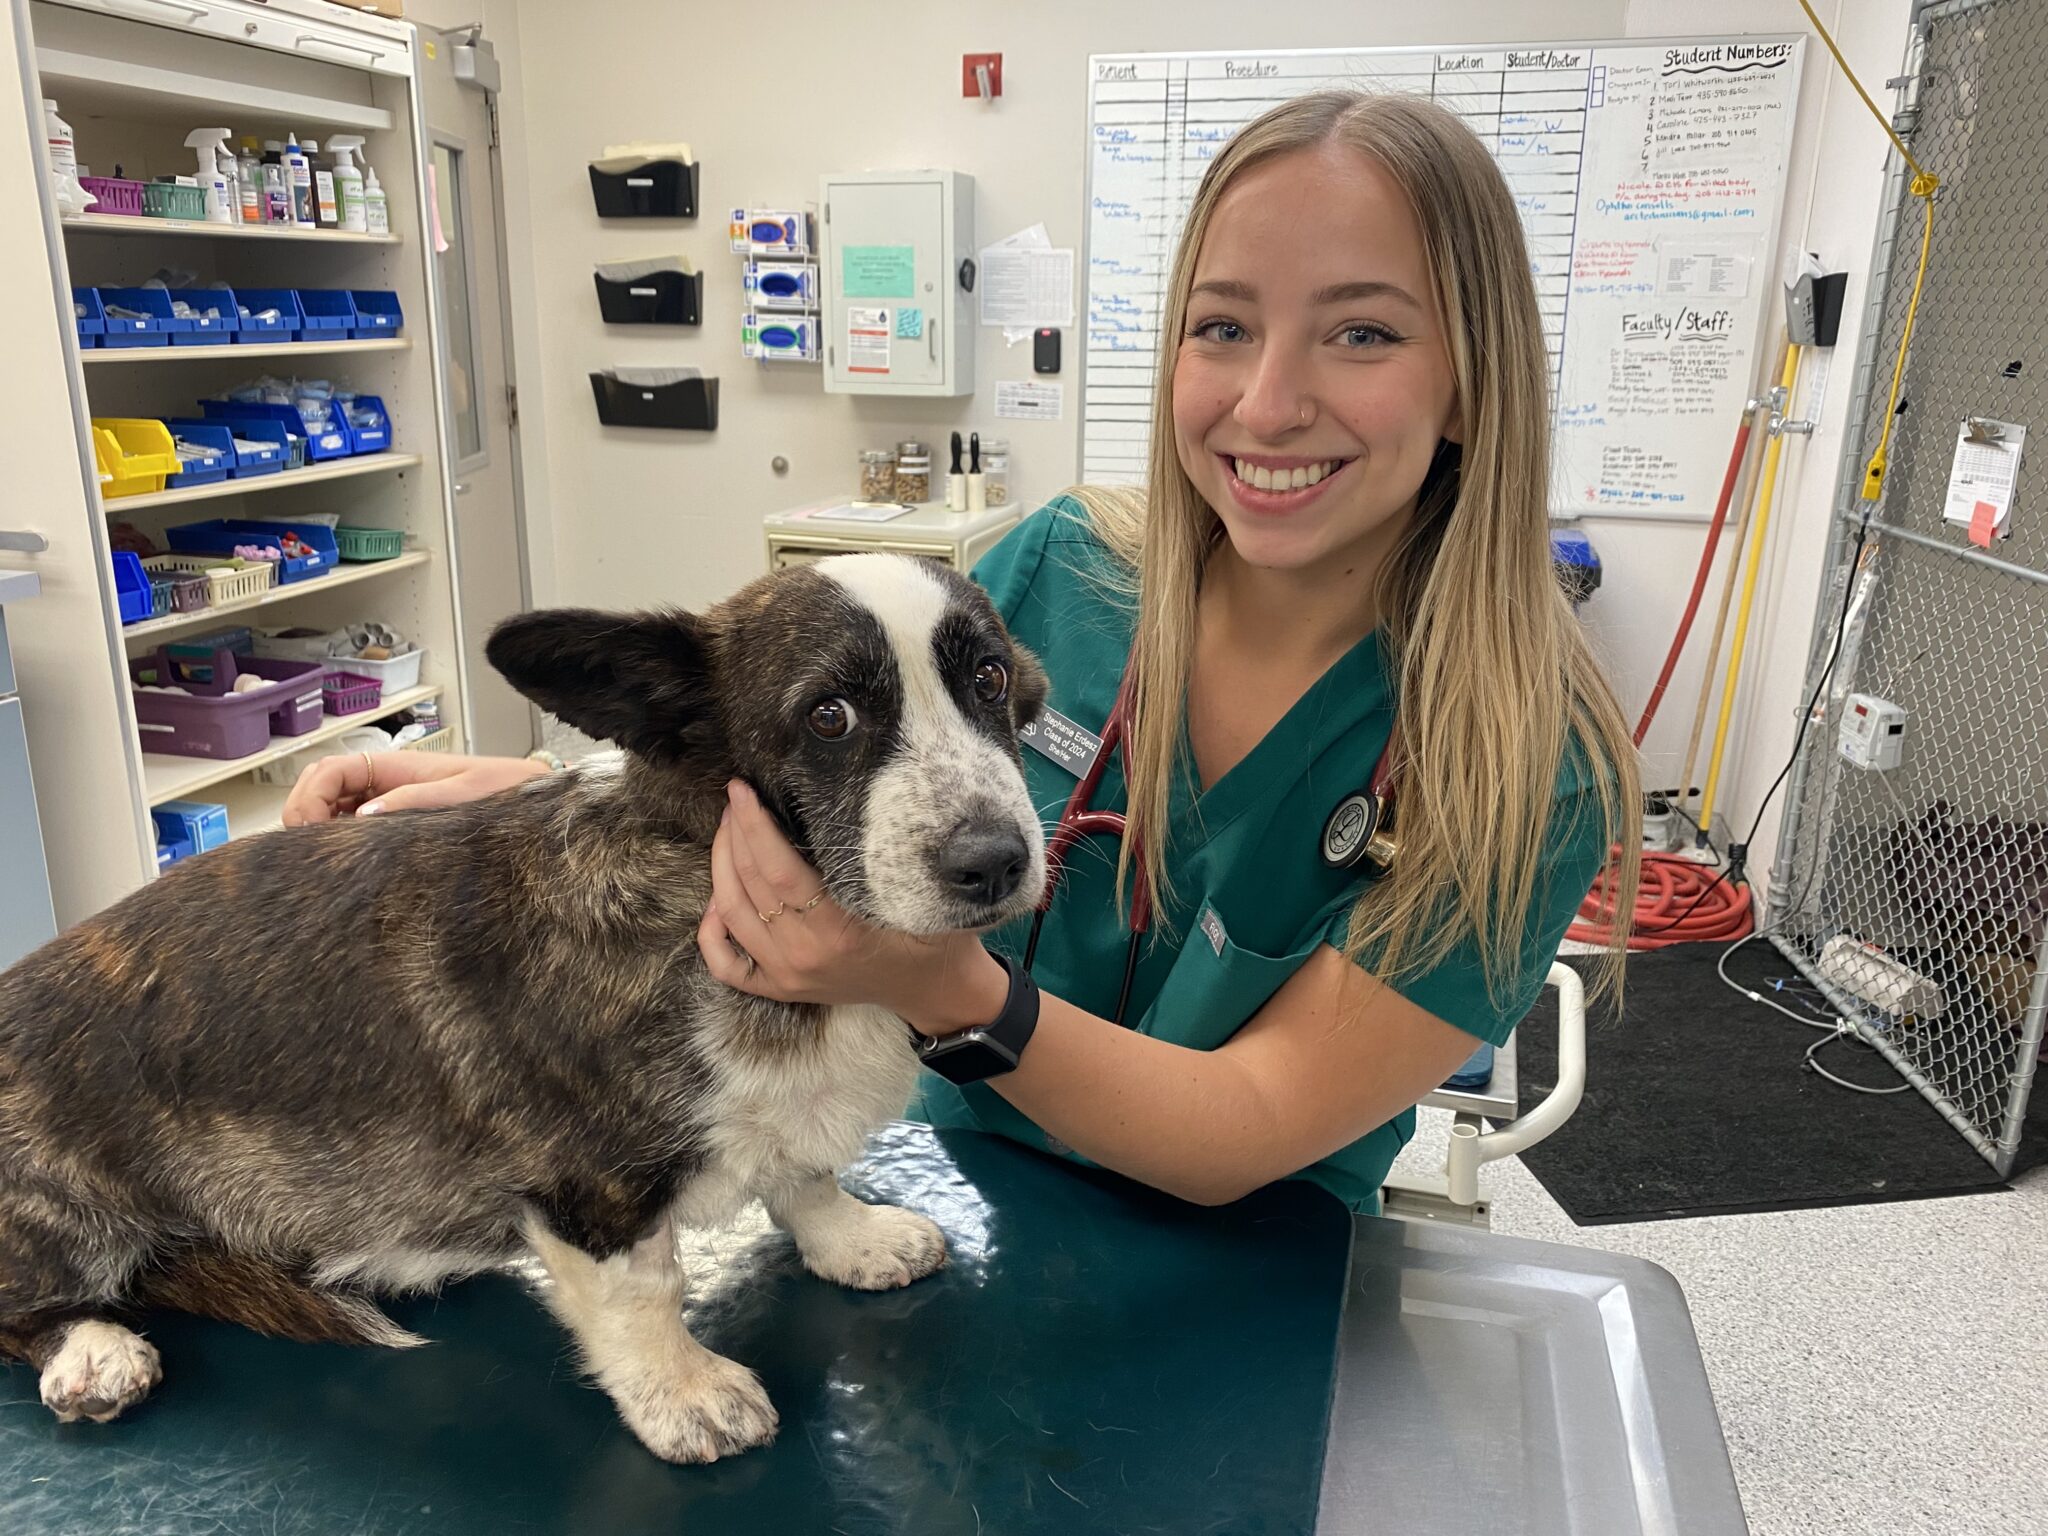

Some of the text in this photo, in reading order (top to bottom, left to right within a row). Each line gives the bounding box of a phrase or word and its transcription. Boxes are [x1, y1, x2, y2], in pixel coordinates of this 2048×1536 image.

[1438, 55, 1484, 70] Location
[1507, 51, 1580, 69] Student/Doctor
[1663, 44, 1792, 67] Student Numbers:
[1099, 63, 1138, 79] Patient
[1225, 61, 1279, 78] Procedure
[1644, 134, 1652, 147] 5
[1043, 712, 1098, 752] Stephanie Erdesz
[1043, 727, 1087, 759] Class of 2024
